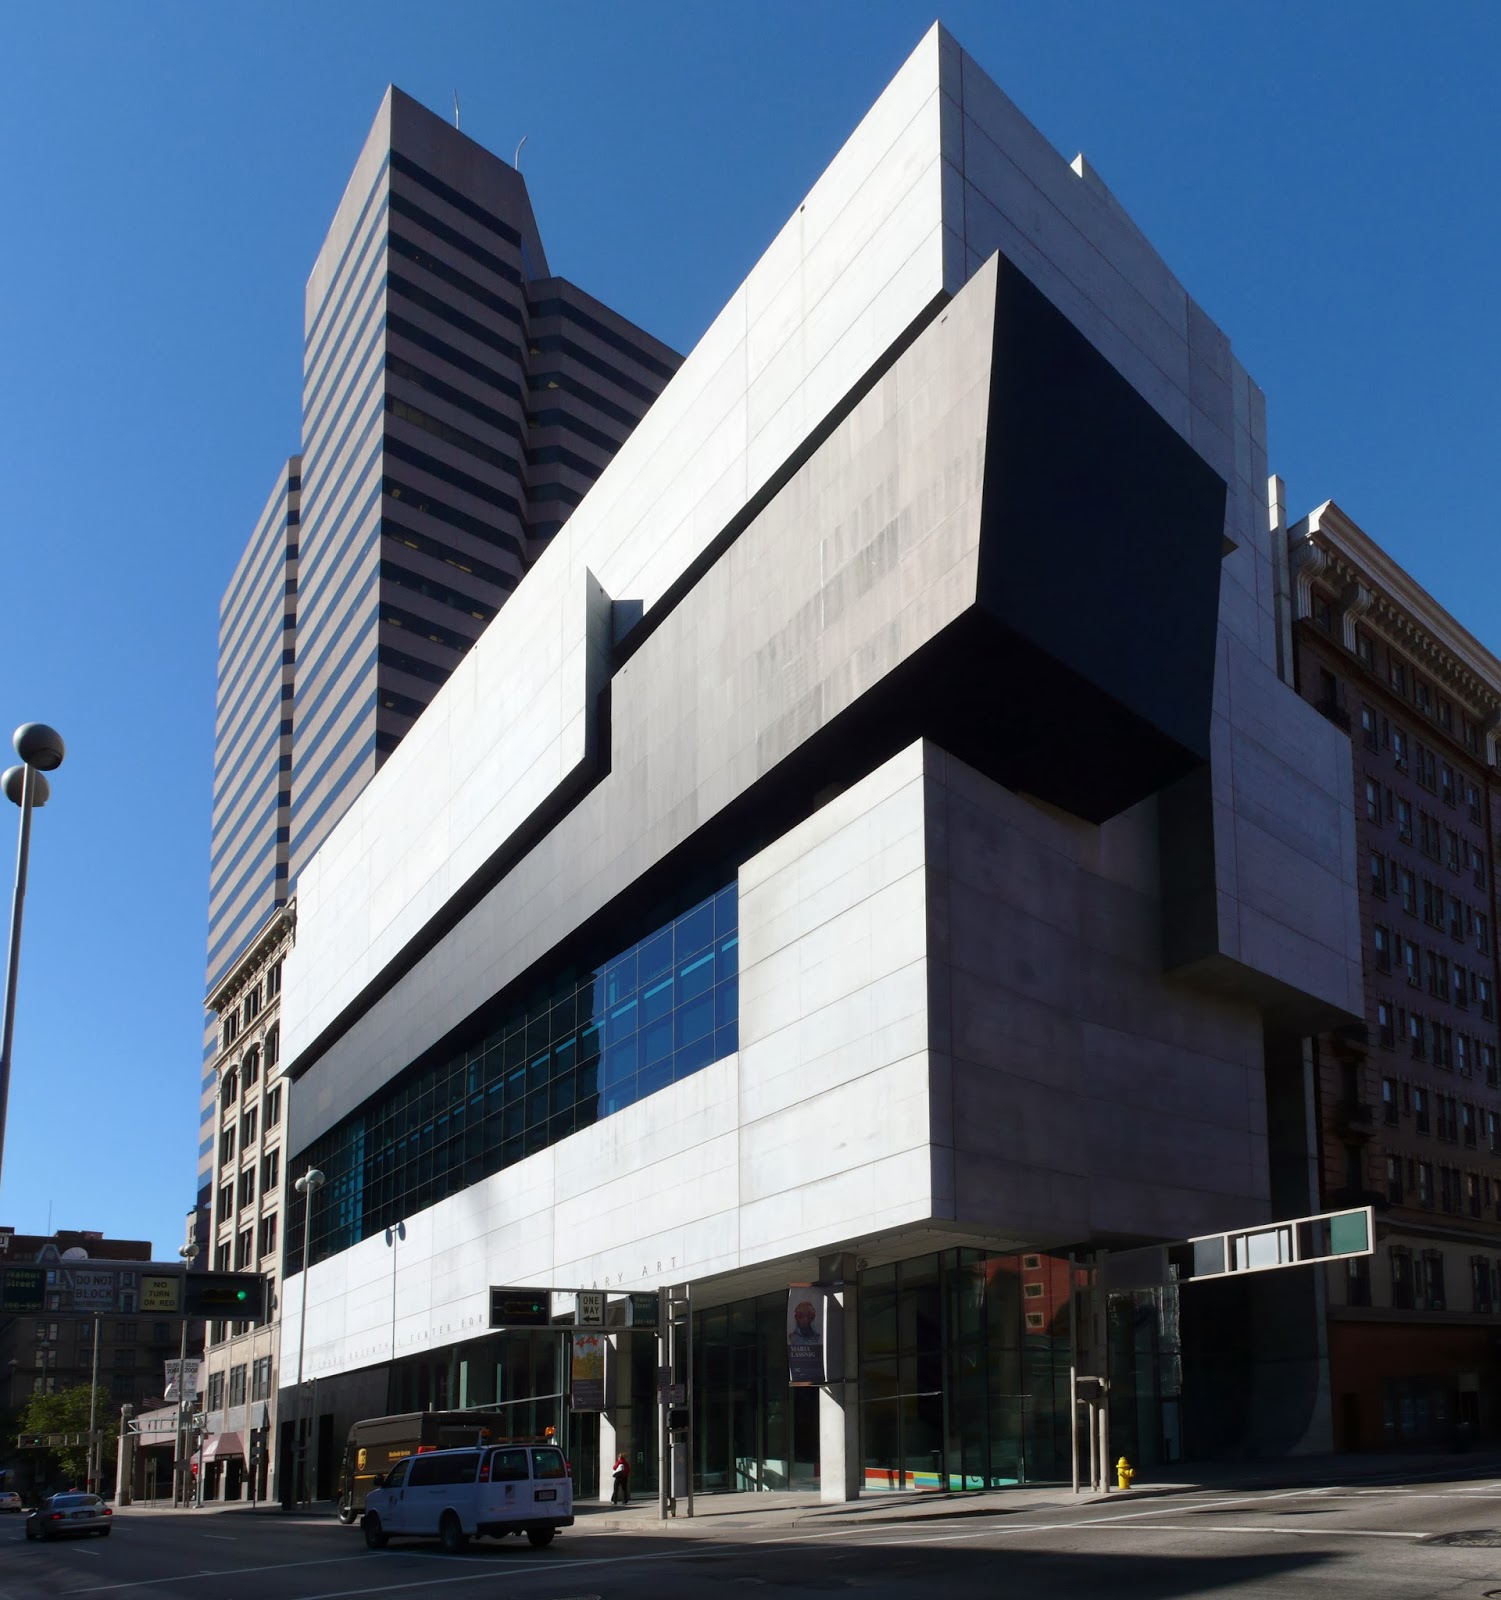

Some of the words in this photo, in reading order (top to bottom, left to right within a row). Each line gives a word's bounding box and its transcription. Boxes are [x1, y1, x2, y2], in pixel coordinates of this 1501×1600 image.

[642, 1257, 676, 1276] ART
[6, 1271, 41, 1279] Walnut
[7, 1280, 36, 1288] Street
[76, 1276, 90, 1285] DO
[93, 1276, 113, 1285] NOT
[76, 1289, 112, 1298] BLOCK
[583, 1296, 600, 1305] ONE
[583, 1306, 599, 1315] WAY
[410, 1323, 450, 1343] CENTER
[461, 1314, 483, 1329] FOR
